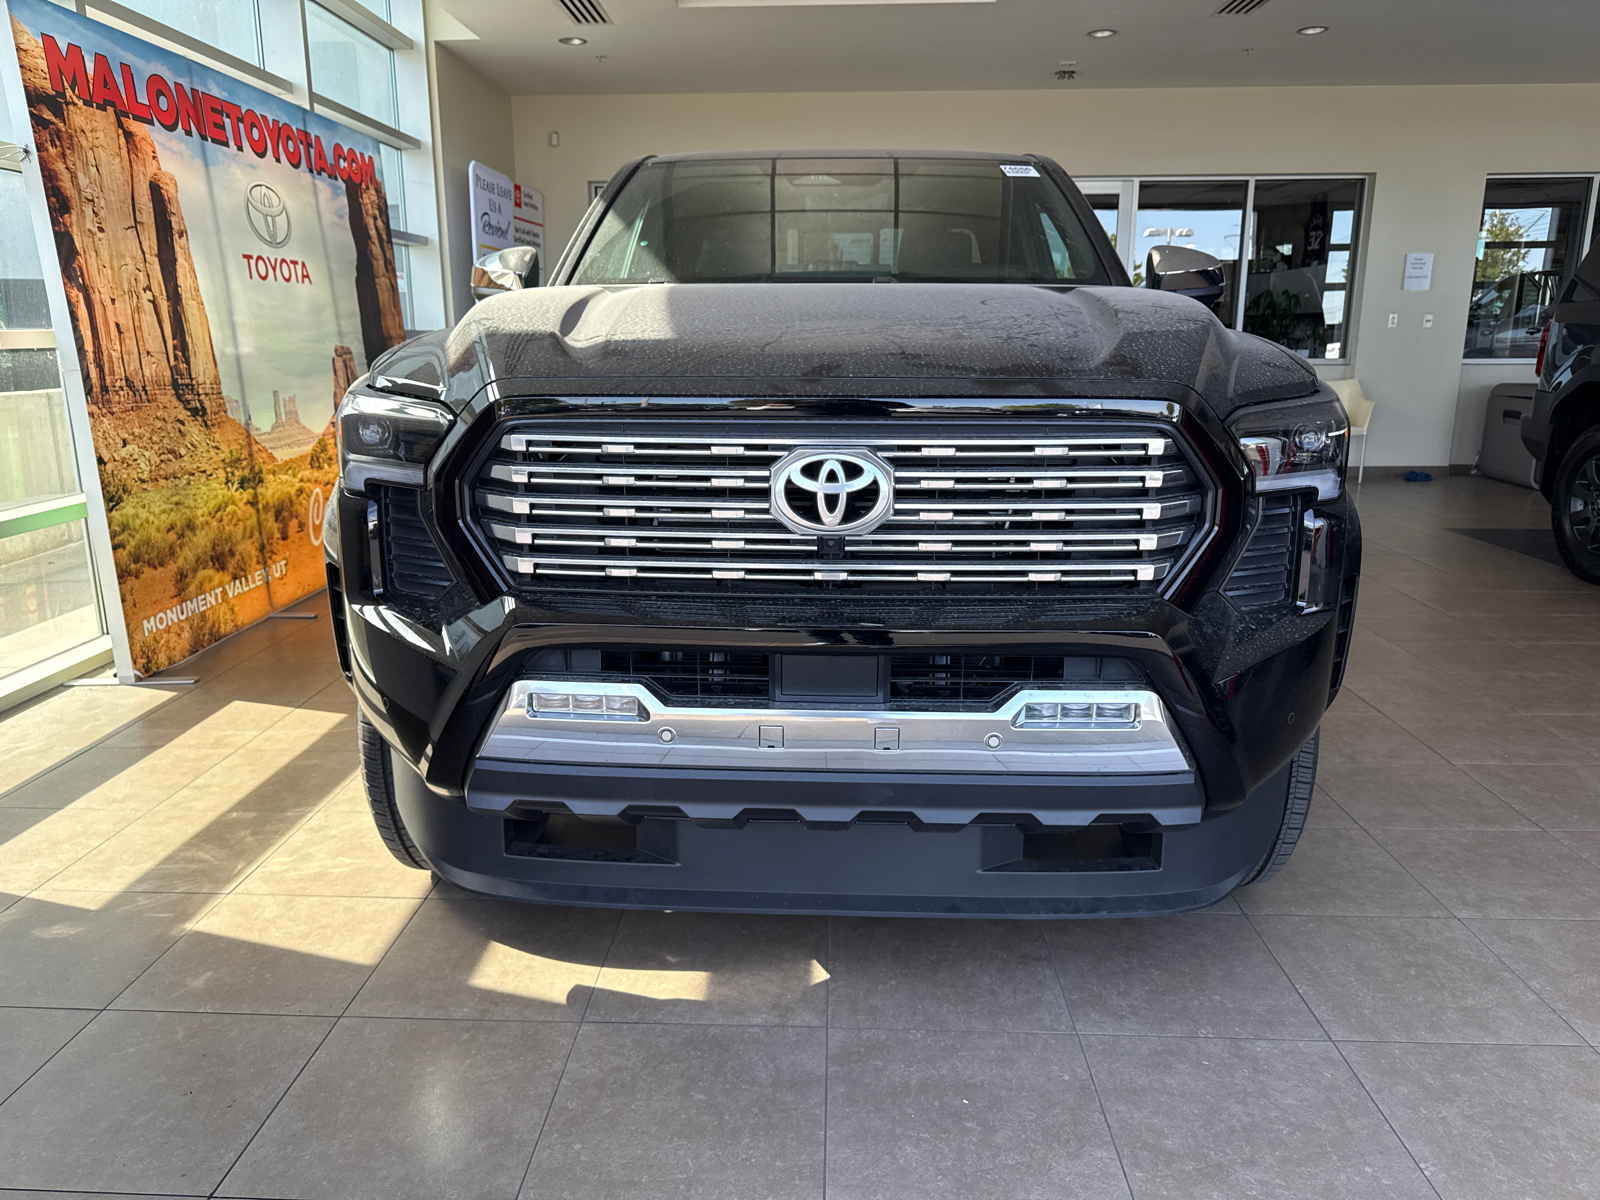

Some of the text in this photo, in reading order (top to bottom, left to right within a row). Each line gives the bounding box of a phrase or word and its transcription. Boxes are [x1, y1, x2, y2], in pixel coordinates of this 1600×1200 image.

[40, 32, 377, 188] MALONETOYOTA.COM
[476, 174, 512, 201] PLEASE LEAVE
[481, 212, 510, 240] Review!
[1307, 230, 1323, 250] 32
[242, 253, 313, 285] TOYOTA
[142, 559, 288, 637] MONUMENT VALLEY, UT
